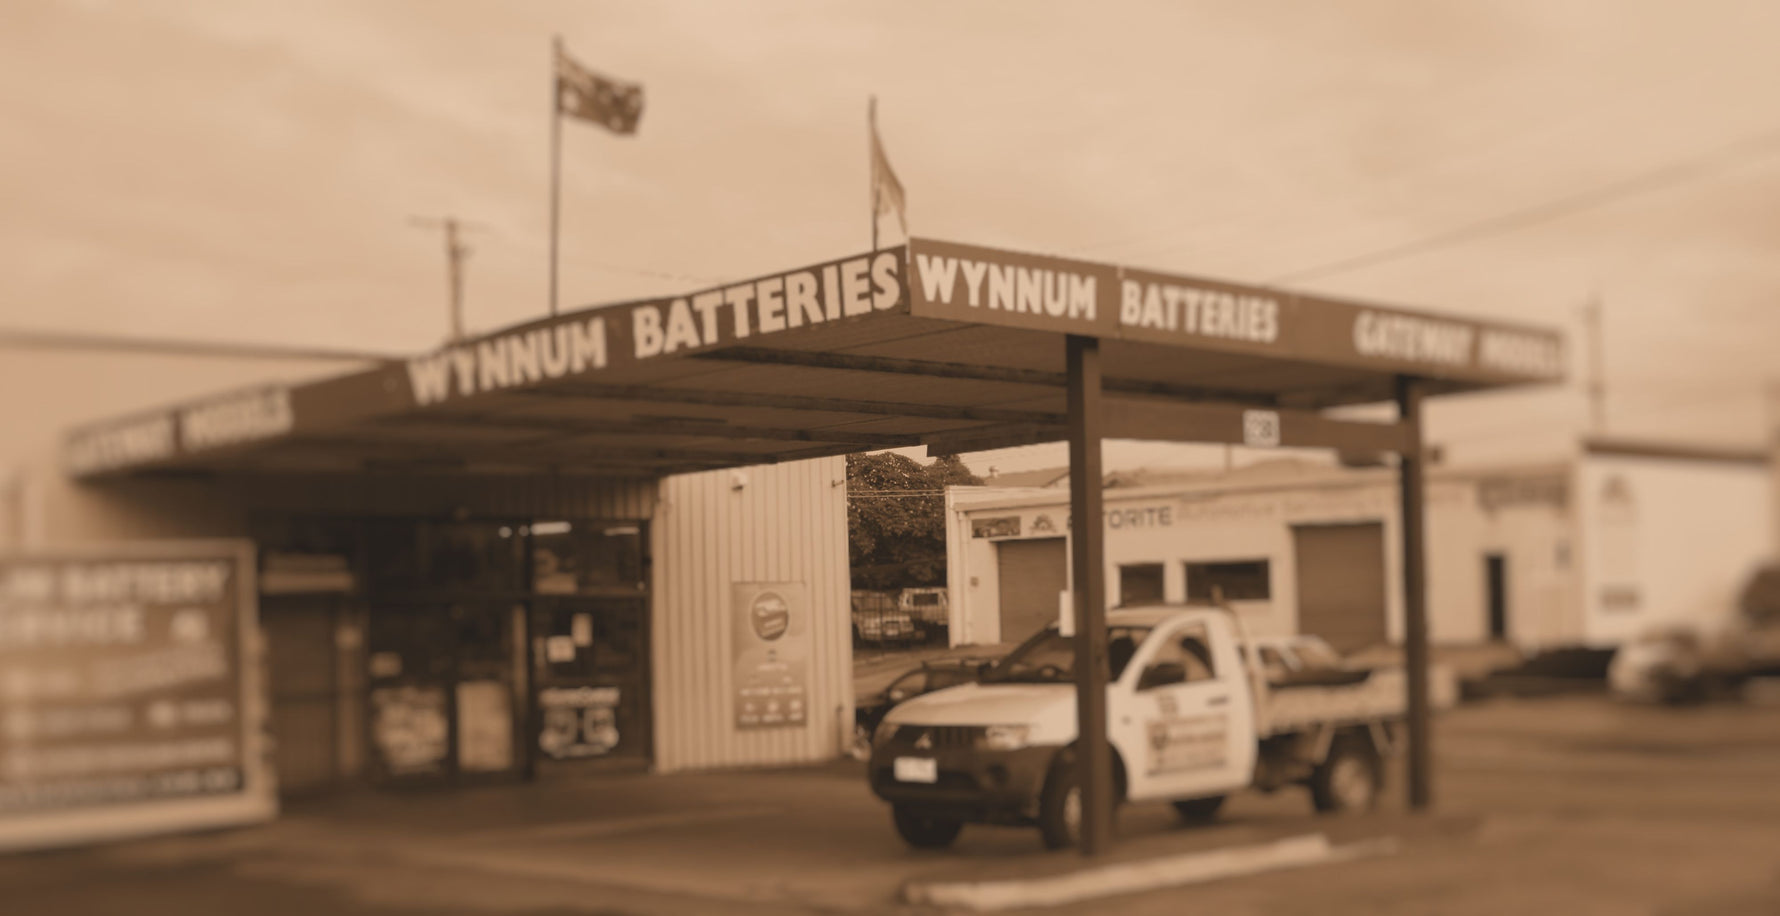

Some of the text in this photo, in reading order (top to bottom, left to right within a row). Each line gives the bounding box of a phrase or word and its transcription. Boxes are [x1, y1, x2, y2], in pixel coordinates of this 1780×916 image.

[406, 253, 901, 406] WYNNUM BATTERIES
[916, 254, 1279, 342] WYNNUM BATTERIES
